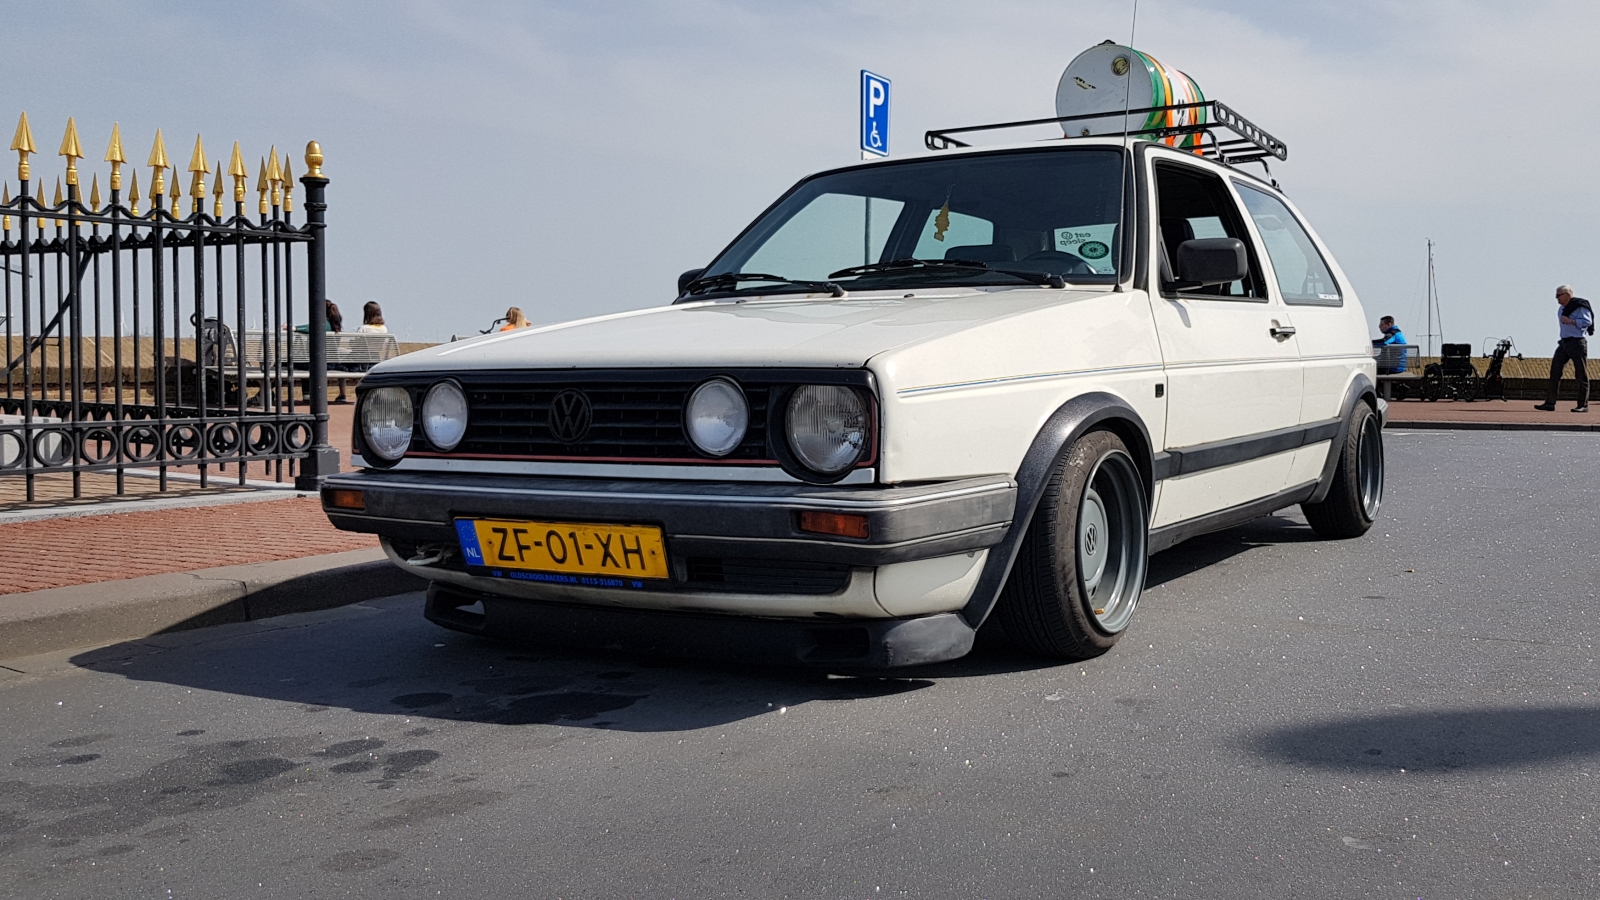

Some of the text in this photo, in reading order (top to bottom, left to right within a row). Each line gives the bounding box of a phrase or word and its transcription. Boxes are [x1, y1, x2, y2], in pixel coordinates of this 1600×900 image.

[869, 79, 885, 118] P
[549, 389, 591, 443] VW
[466, 547, 481, 559] NL
[492, 526, 647, 571] ZF-01-XH
